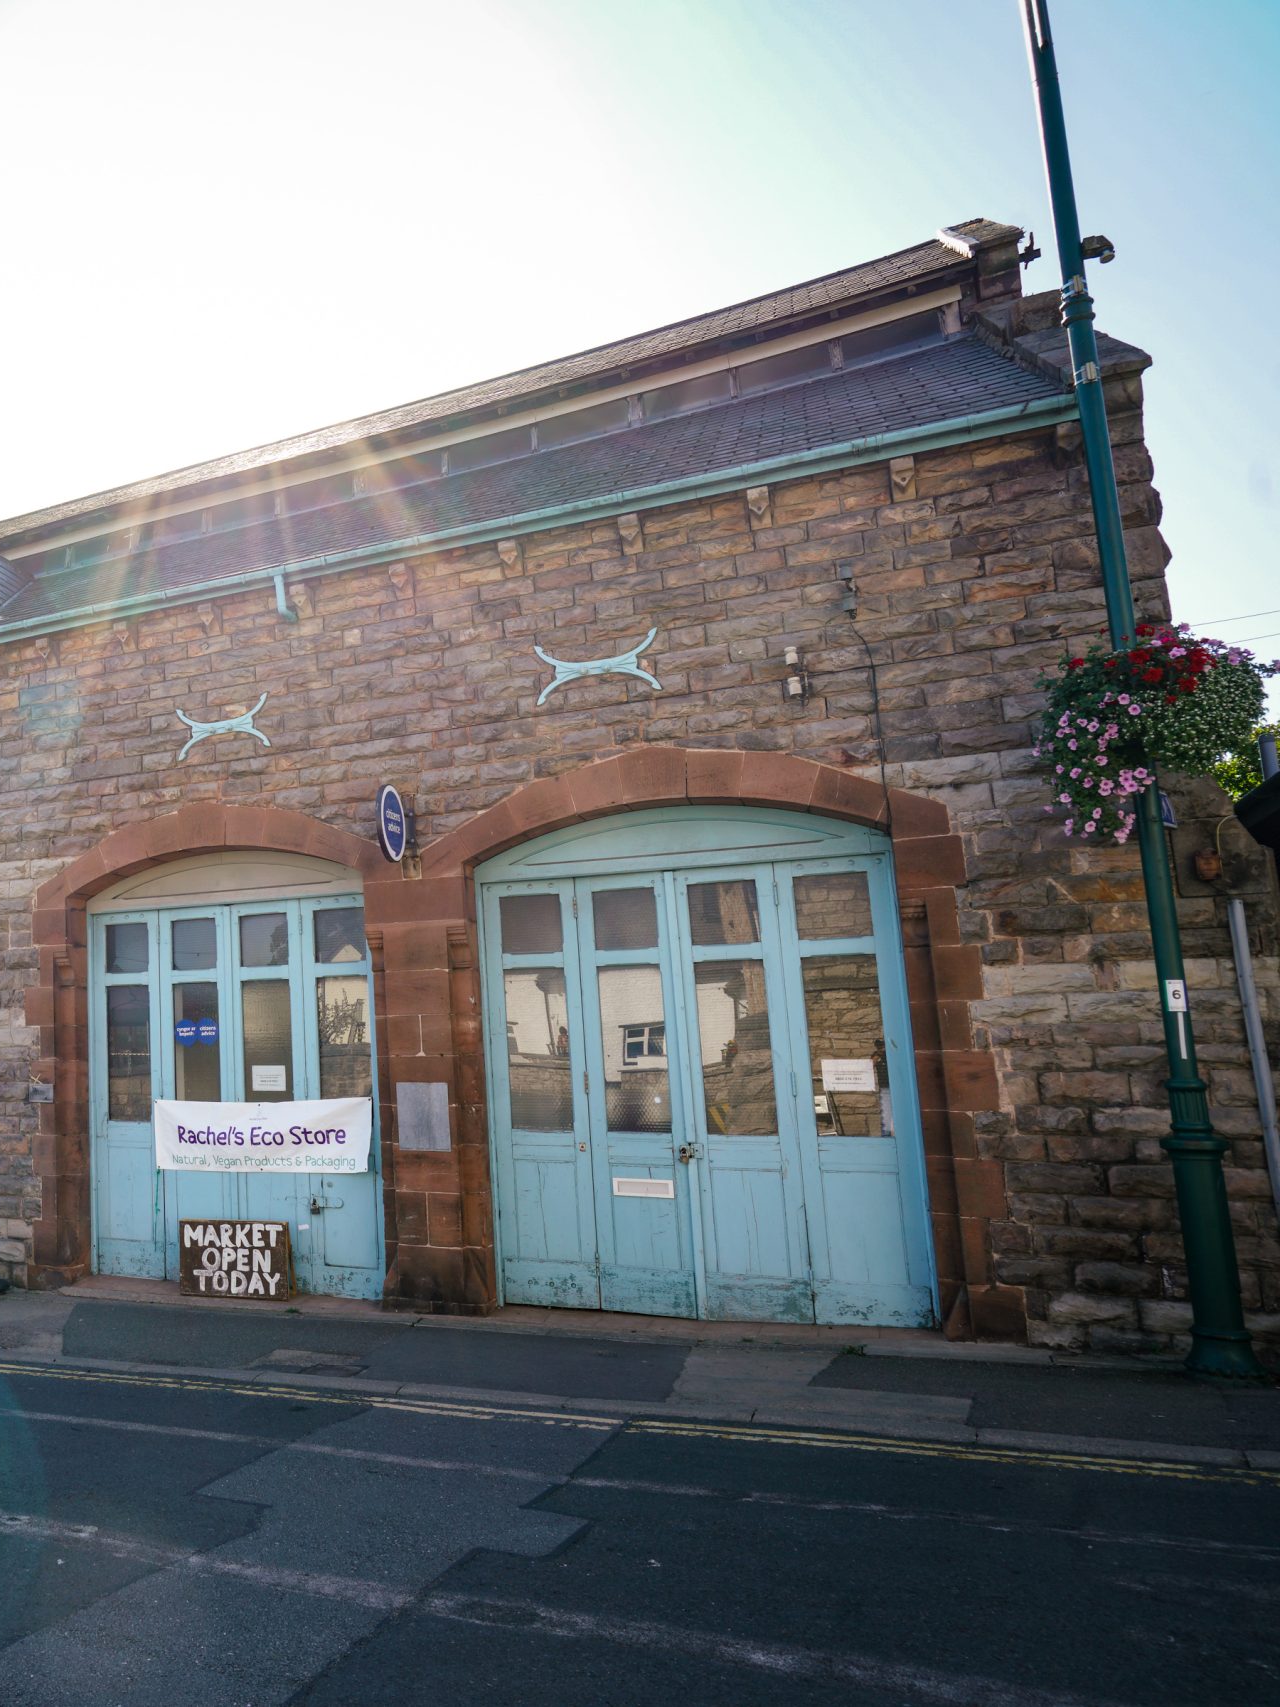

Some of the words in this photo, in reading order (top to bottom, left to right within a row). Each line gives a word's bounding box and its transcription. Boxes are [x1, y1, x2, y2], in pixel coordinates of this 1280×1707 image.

[1172, 990, 1181, 999] 6
[177, 1125, 245, 1146] Rachel's
[250, 1127, 285, 1146] Eco
[289, 1126, 346, 1146] Store
[172, 1155, 211, 1167] Natural,
[213, 1155, 242, 1169] Vegan
[244, 1155, 293, 1167] Products
[296, 1156, 302, 1166] &
[305, 1155, 356, 1170] Packaging
[183, 1224, 283, 1248] MARKET
[201, 1248, 271, 1273] OPEN
[193, 1270, 281, 1296] TODAY
